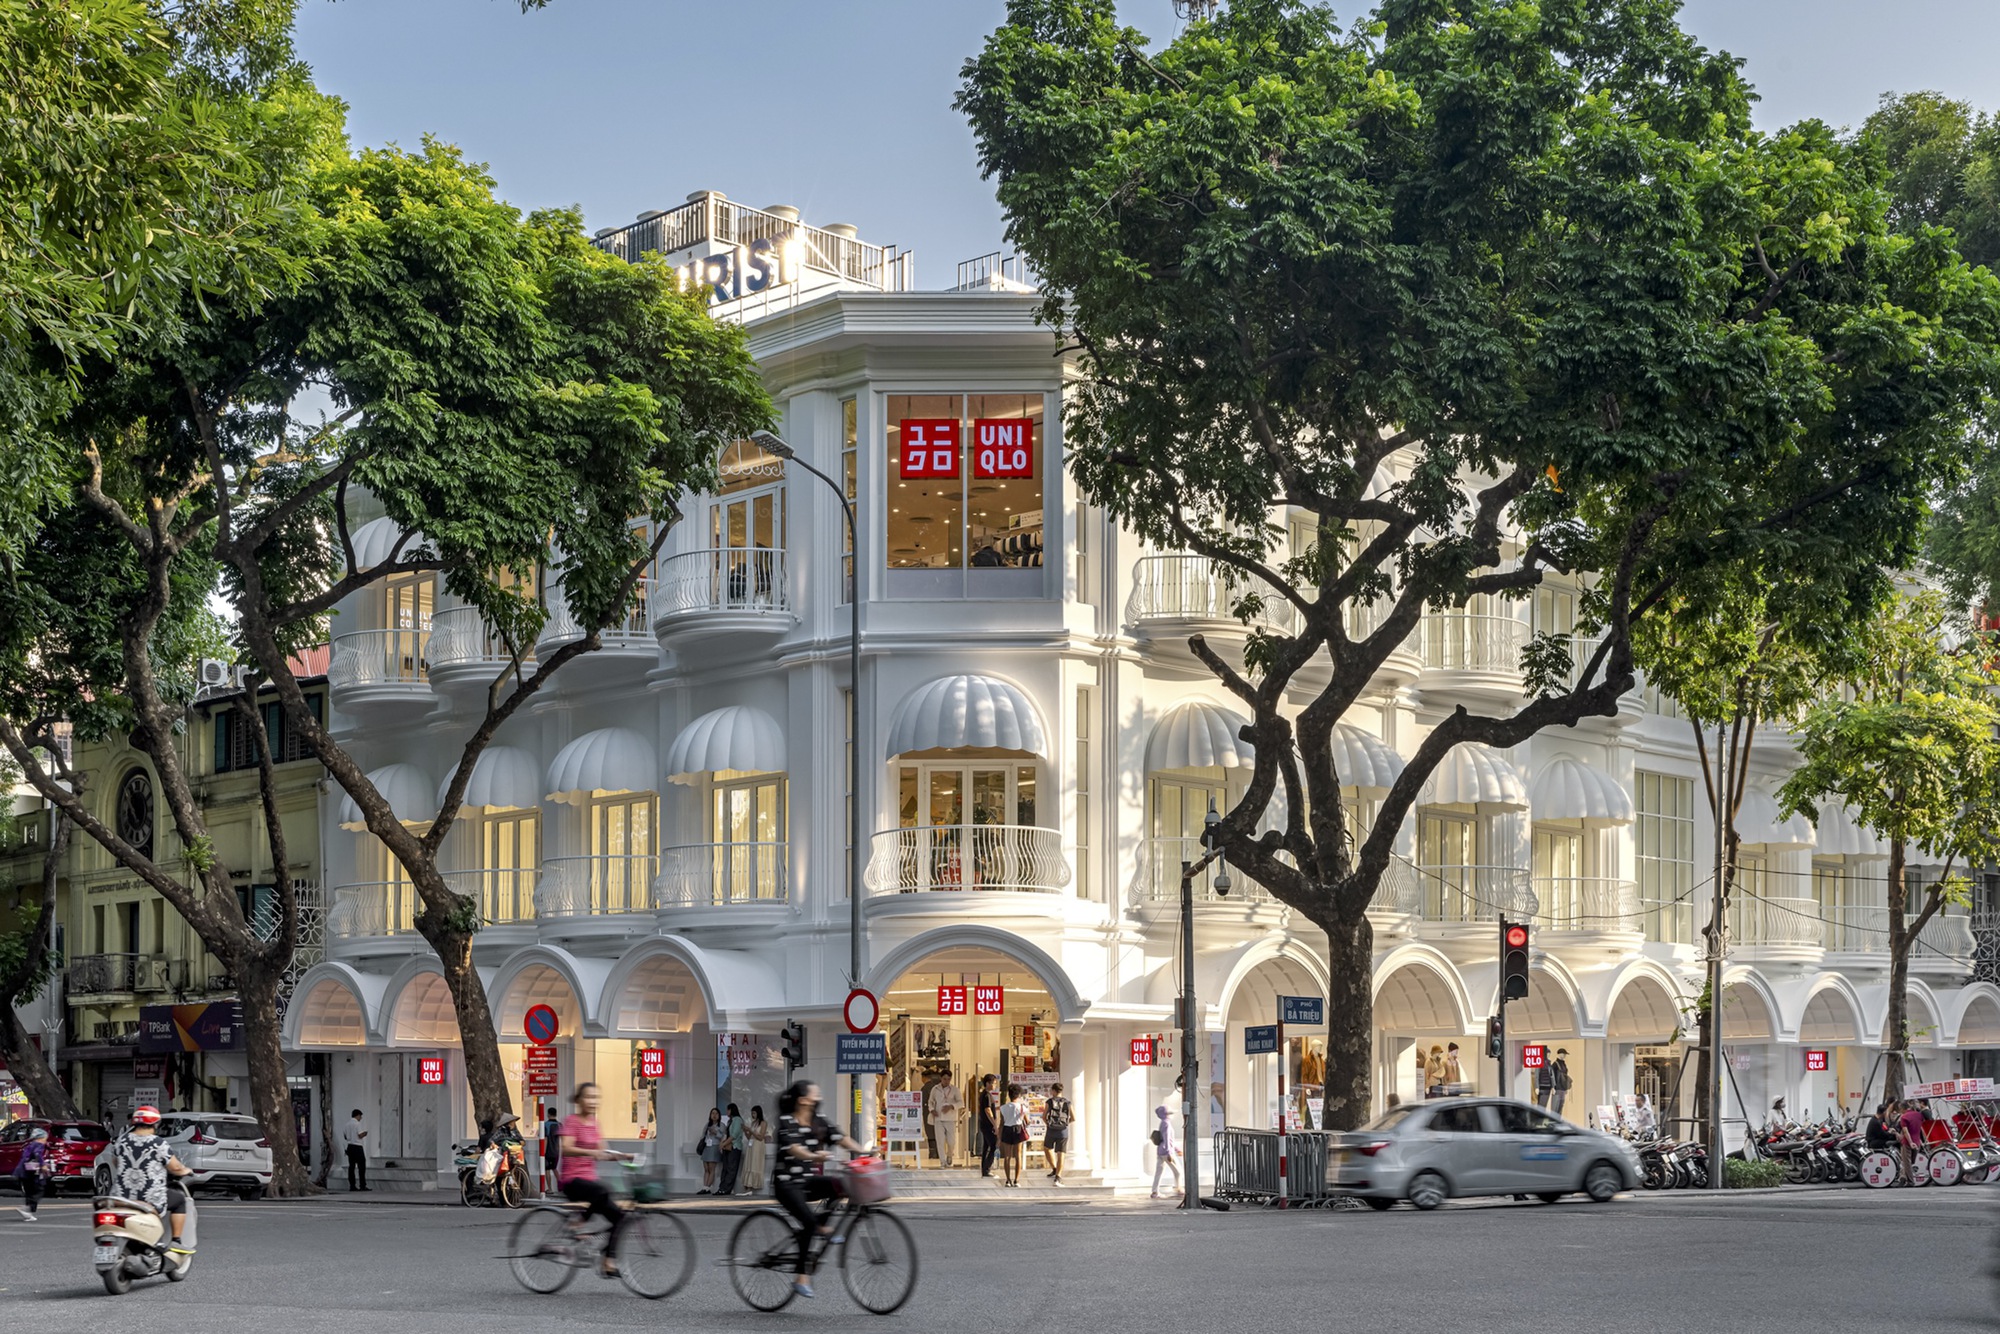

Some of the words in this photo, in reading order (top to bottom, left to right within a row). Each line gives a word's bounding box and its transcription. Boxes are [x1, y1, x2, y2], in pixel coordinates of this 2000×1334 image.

[908, 426, 952, 446] ユニ
[980, 426, 1022, 446] UNI
[907, 450, 952, 470] クロ
[980, 450, 1026, 474] QLO
[941, 989, 963, 999] ユニ
[978, 989, 998, 1000] UNI
[941, 1002, 963, 1012] クロ
[978, 1001, 1000, 1013] QLO
[1288, 1008, 1298, 1020] BÀ
[1299, 1009, 1320, 1022] TRIỆU
[148, 1022, 170, 1032] TPBank
[720, 1034, 758, 1045] KHAI
[842, 1037, 858, 1049] TUYẾN
[1133, 1042, 1148, 1052] UNI
[1525, 1048, 1540, 1056] UNI
[644, 1052, 661, 1062] UNI
[1133, 1054, 1150, 1064] QLO
[1525, 1057, 1542, 1066] QLO
[423, 1062, 440, 1070] UNI
[644, 1064, 662, 1075] QLO
[423, 1072, 441, 1082] QLO
